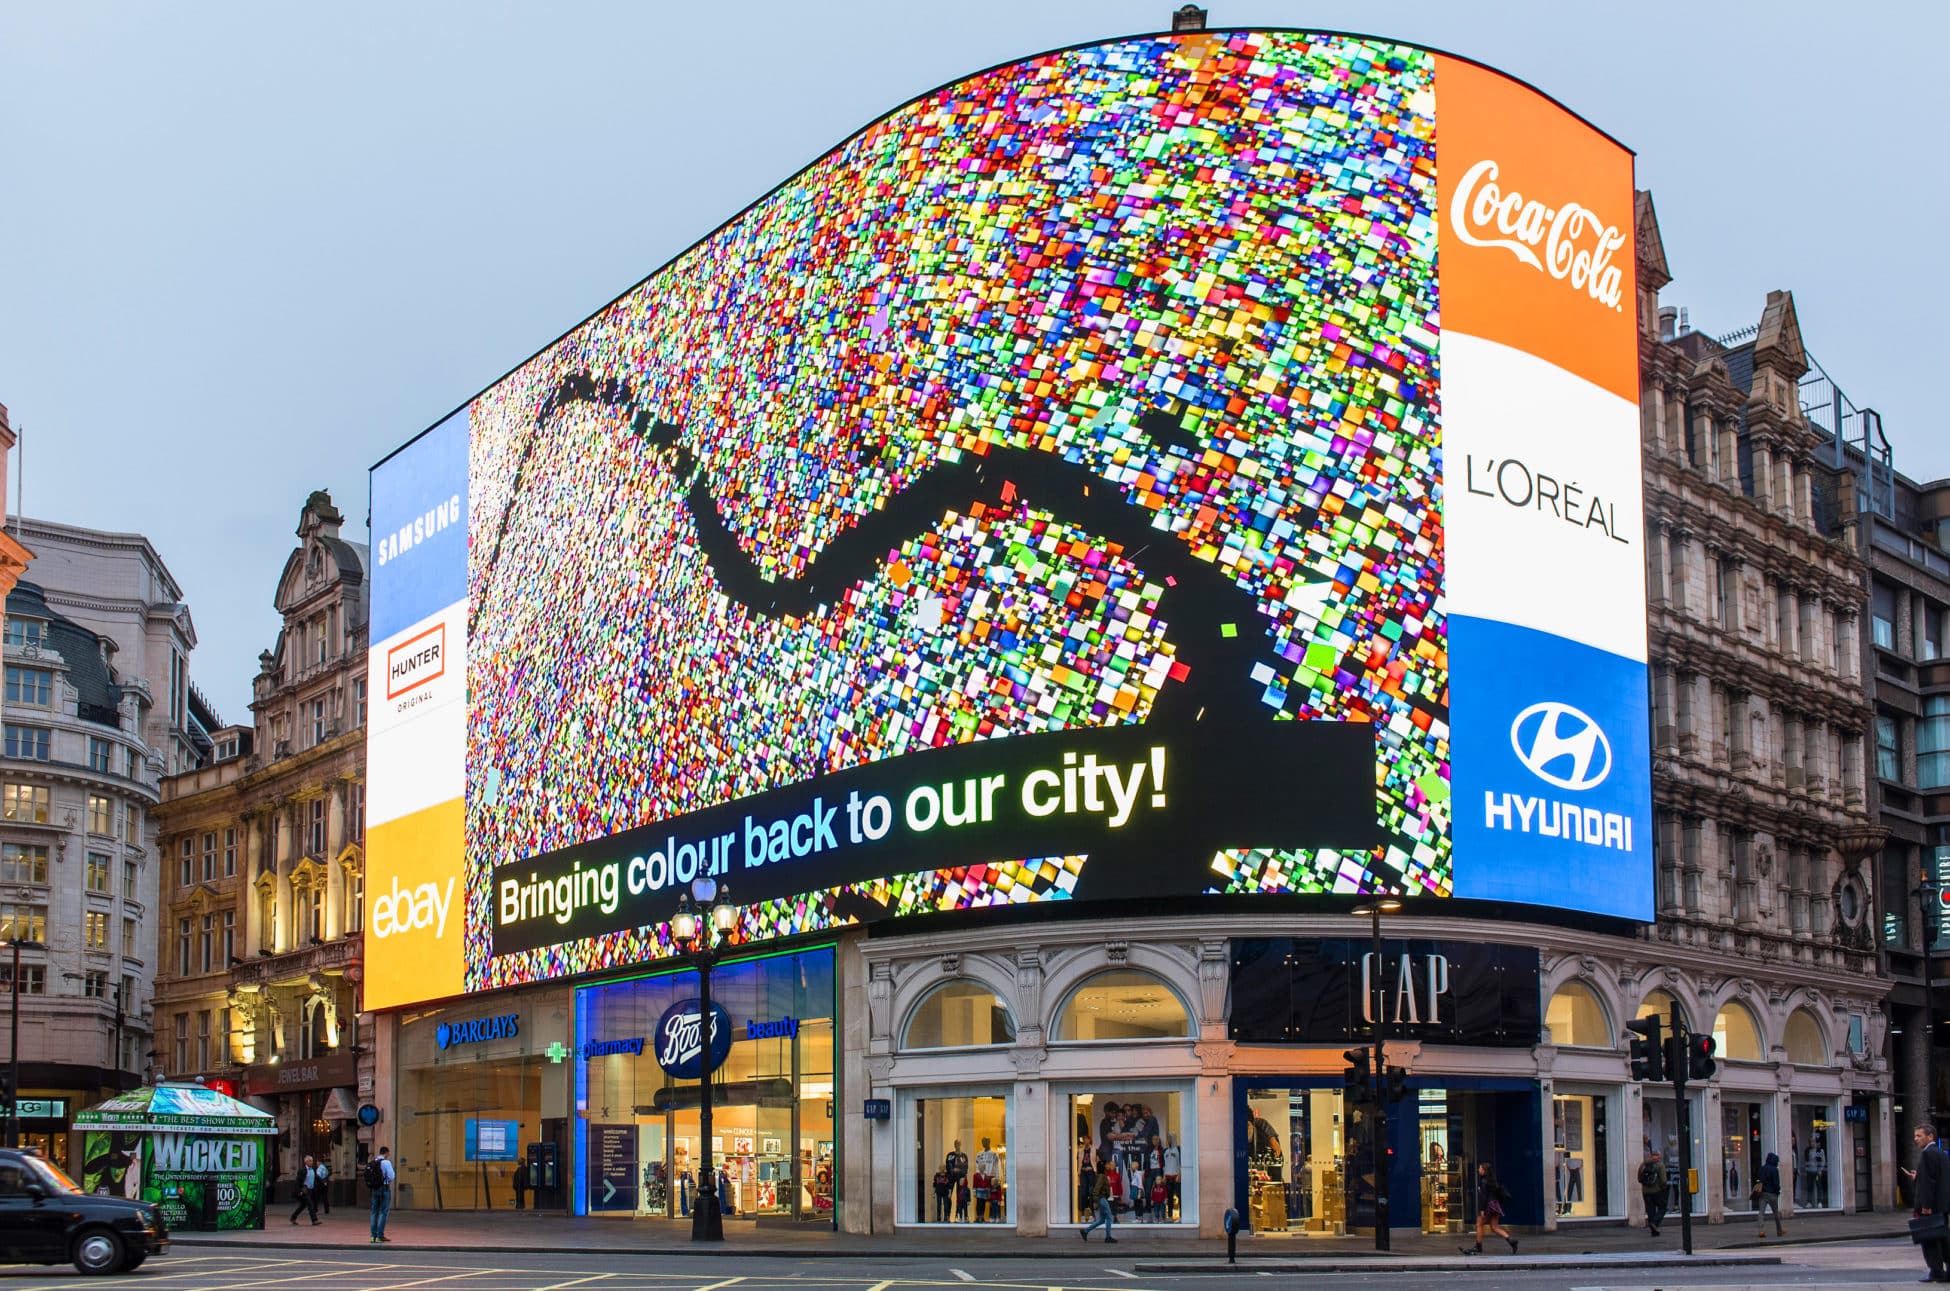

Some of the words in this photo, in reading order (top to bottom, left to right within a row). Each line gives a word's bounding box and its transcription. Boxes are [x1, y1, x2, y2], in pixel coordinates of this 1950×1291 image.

[1450, 159, 1626, 312] Coca-Cola
[1467, 454, 1629, 544] L'ORÉAL
[378, 495, 460, 566] SAMSUNG
[391, 644, 440, 681] HUNTER
[397, 692, 433, 713] ORIGINAL
[500, 861, 619, 926] Bringing
[627, 836, 735, 896] colour
[745, 797, 839, 868] back
[847, 790, 892, 844] to
[905, 774, 1005, 832] our
[1021, 746, 1166, 828] city!
[1484, 790, 1633, 852] HYUNDAI
[372, 875, 456, 939] ebay
[1362, 952, 1448, 1024] GAP
[452, 1013, 519, 1046] BARCLAYS
[583, 1036, 645, 1062] pharmacy
[660, 1012, 717, 1066] Boos
[747, 1015, 800, 1041] beauty
[278, 1067, 300, 1084] JEWEL
[302, 1065, 319, 1081] BAR
[180, 1116, 200, 1124] BEST
[201, 1117, 225, 1125] SHOW
[217, 1188, 235, 1201] 100
